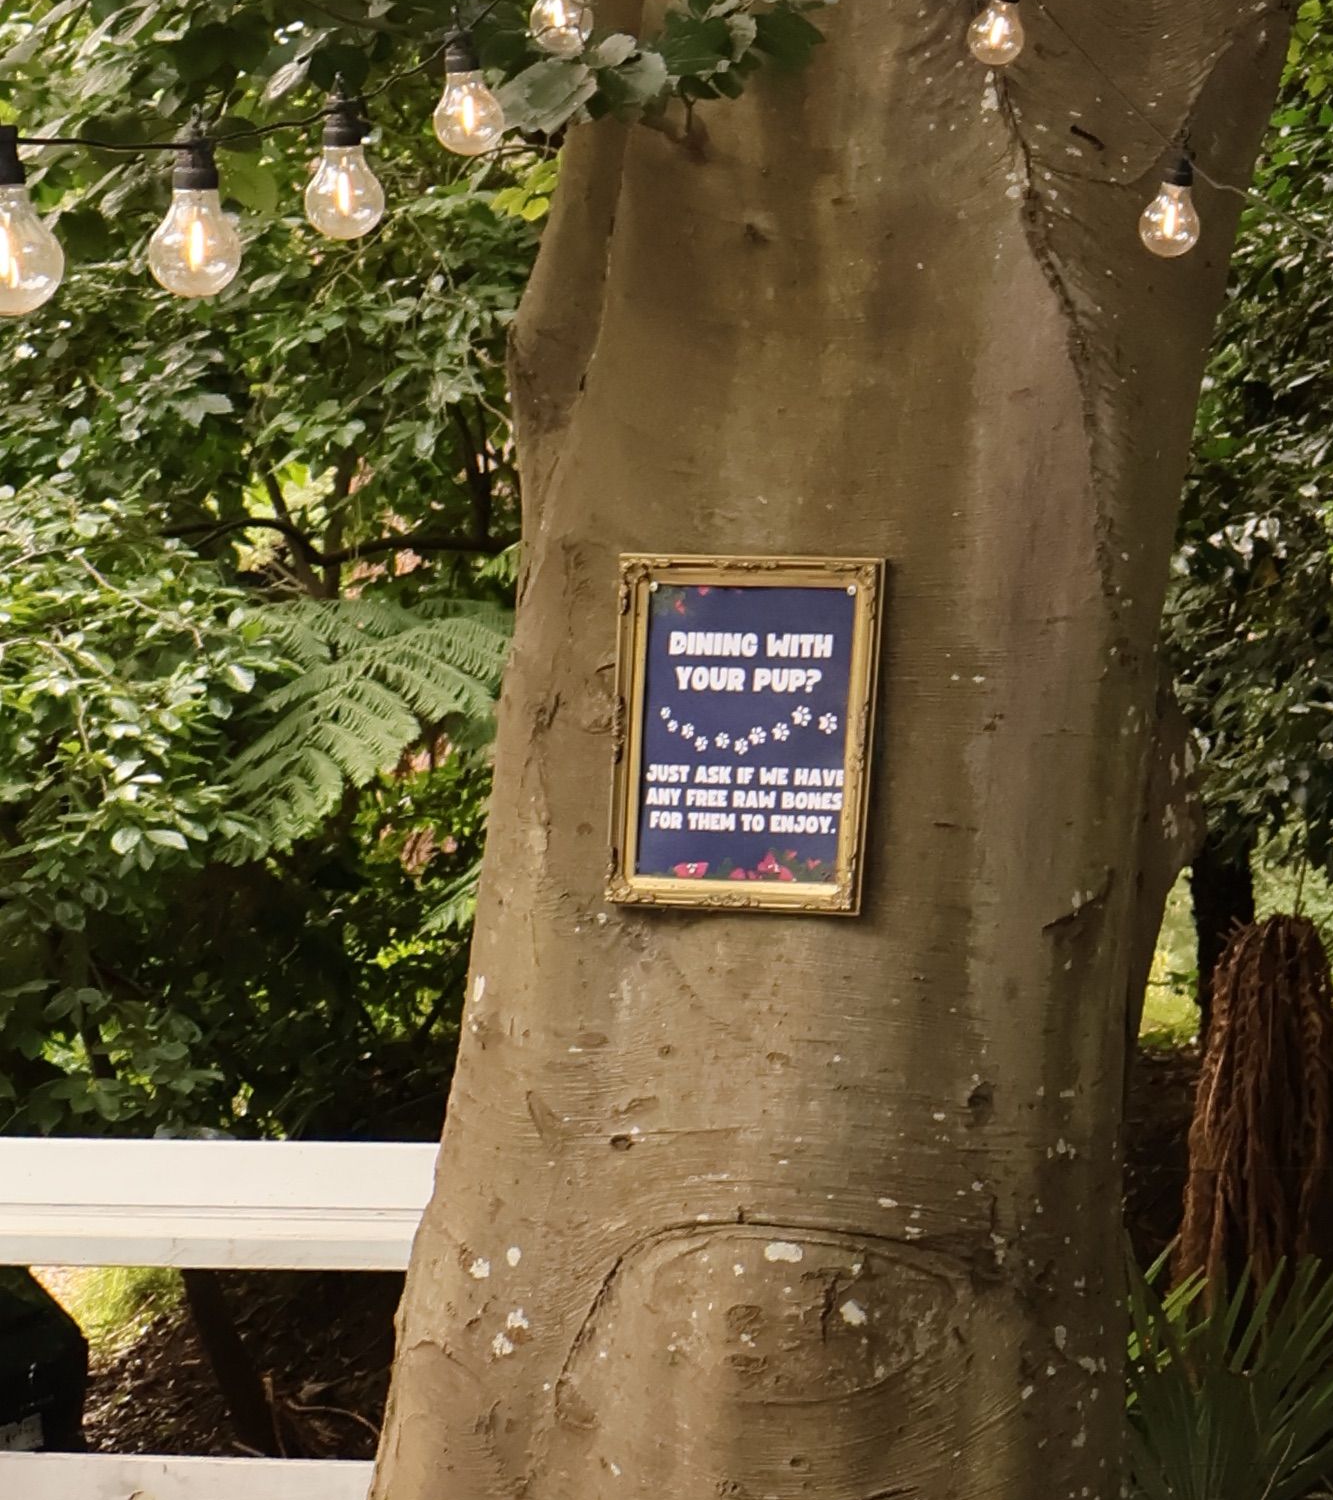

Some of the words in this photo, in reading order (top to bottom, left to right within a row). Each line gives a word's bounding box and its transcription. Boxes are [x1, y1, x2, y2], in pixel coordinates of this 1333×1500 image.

[668, 631, 758, 658] DINING
[766, 633, 834, 658] WITH
[675, 666, 746, 692] YOUR
[752, 668, 822, 693] PUP?
[646, 763, 690, 783] JUST
[694, 765, 732, 784] ASK
[736, 766, 755, 785] IF
[759, 766, 789, 786] WE
[793, 768, 844, 787] HAVE
[645, 787, 682, 806] ANY
[685, 788, 728, 808] FREE
[732, 790, 777, 809] RAW
[781, 791, 843, 811] BONES
[649, 810, 683, 830] FOR
[687, 811, 736, 832] THEM
[741, 813, 765, 832] TO
[769, 813, 836, 834] ENJOY.
